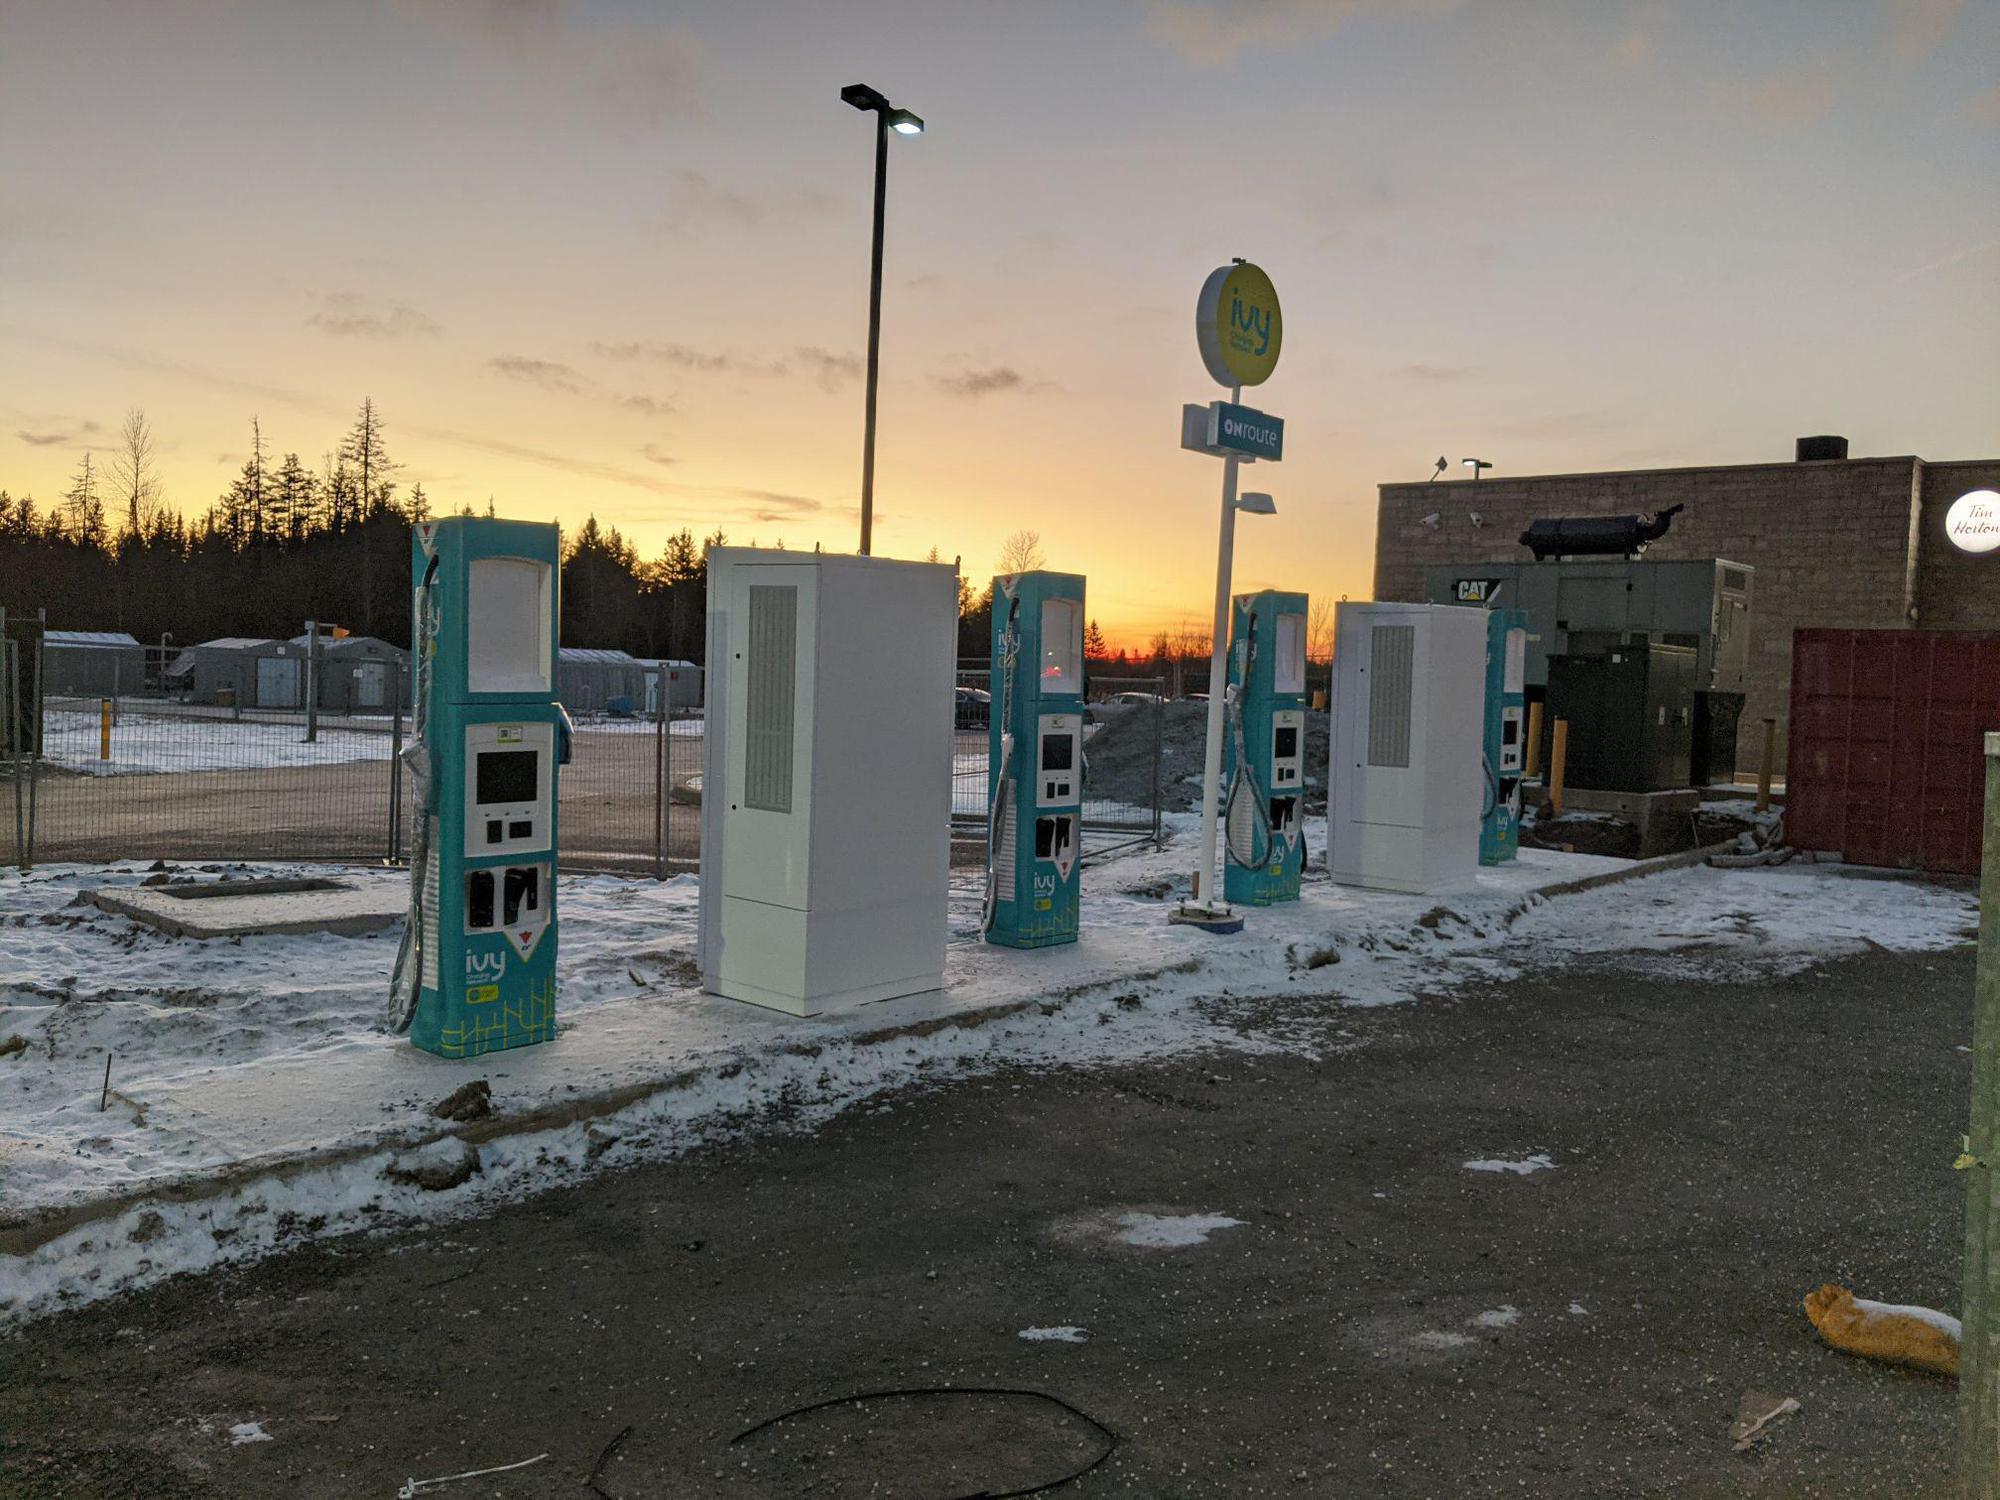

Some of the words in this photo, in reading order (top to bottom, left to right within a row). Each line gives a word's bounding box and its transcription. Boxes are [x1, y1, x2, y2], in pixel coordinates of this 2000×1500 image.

[1232, 287, 1271, 356] ivy
[1968, 504, 1993, 518] Tim
[1458, 580, 1488, 600] CAT
[1034, 872, 1055, 896] ivy
[466, 948, 506, 982] ivy
